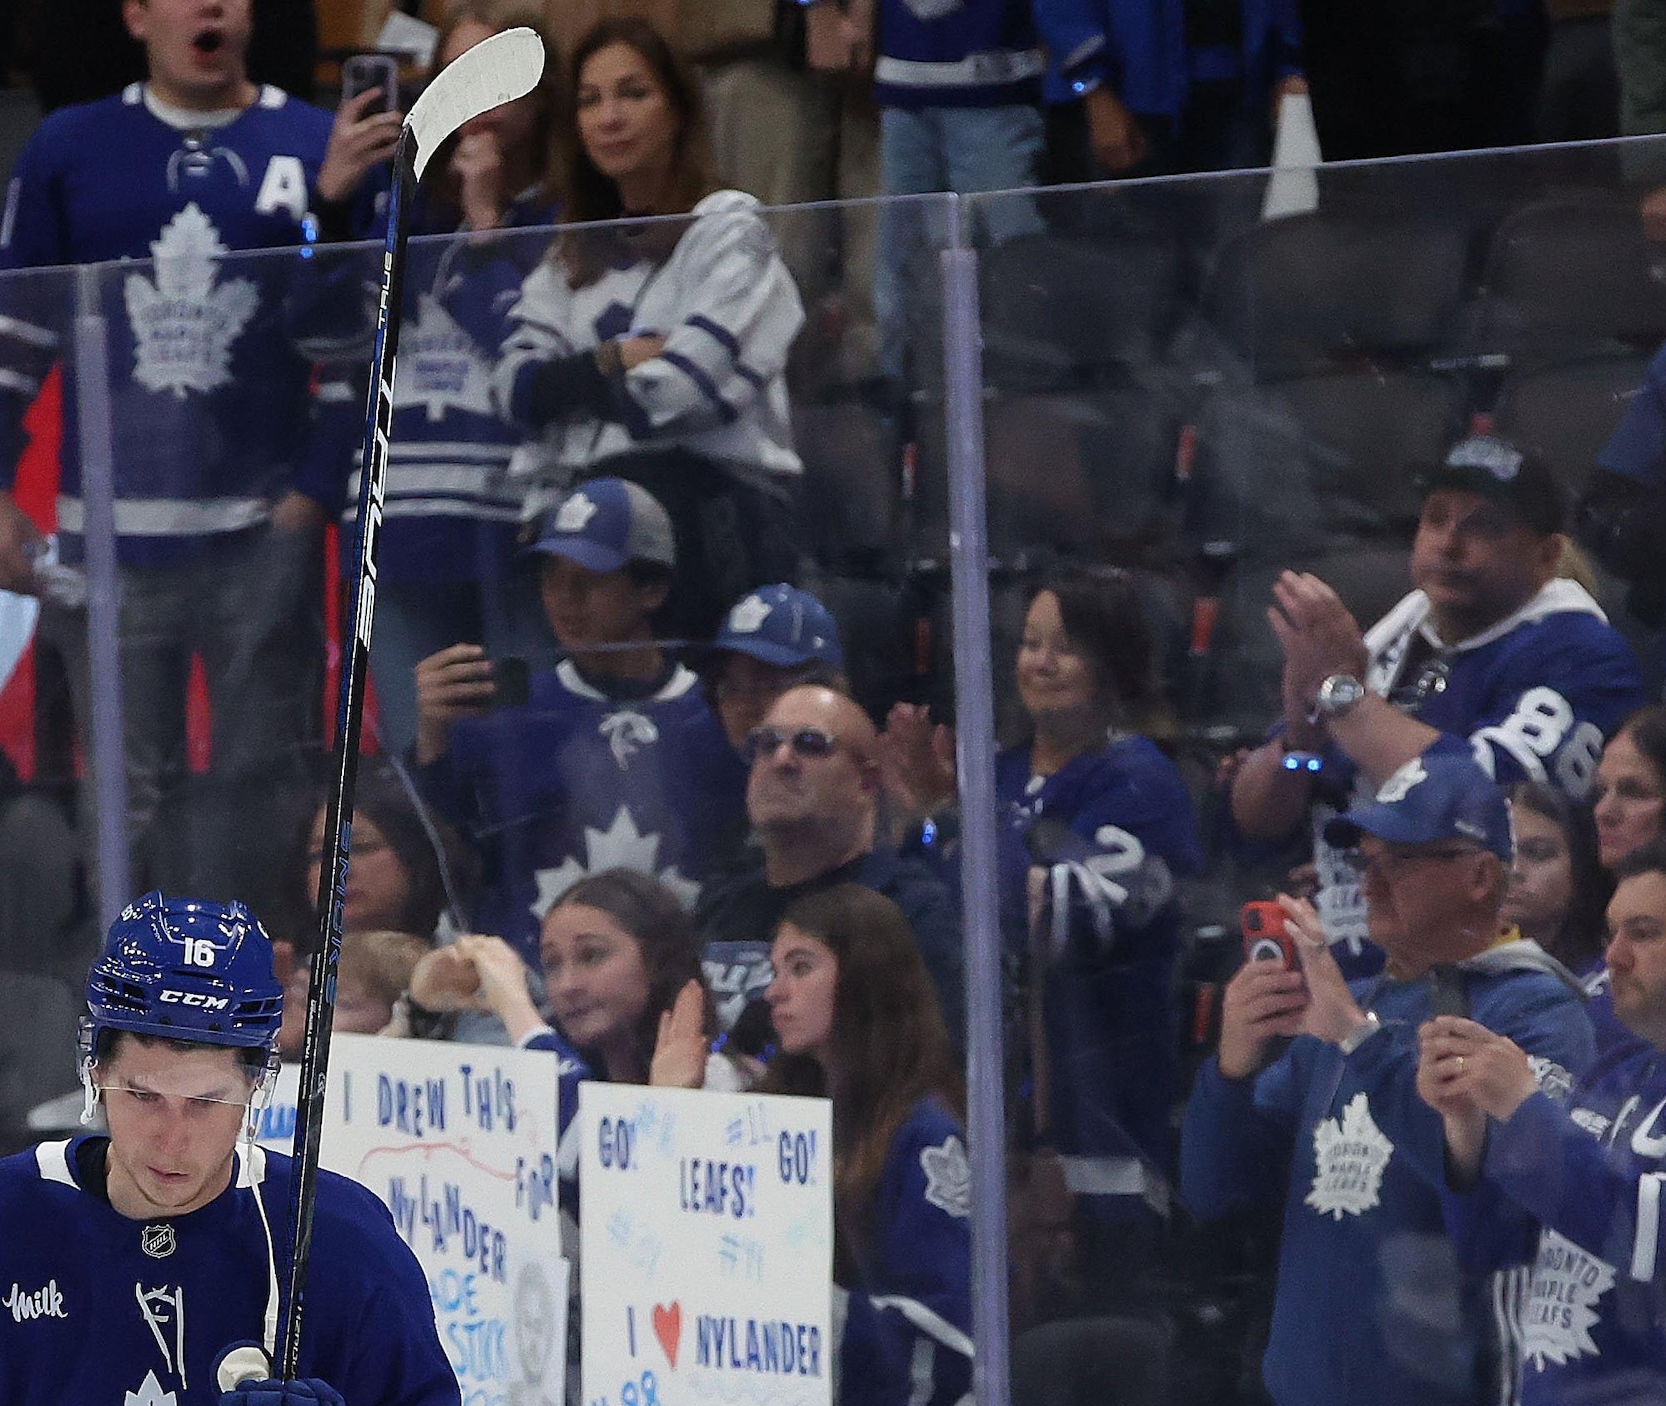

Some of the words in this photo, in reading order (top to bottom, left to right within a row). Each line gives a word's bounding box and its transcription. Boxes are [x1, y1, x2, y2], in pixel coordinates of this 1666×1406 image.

[254, 155, 308, 221] A
[378, 251, 393, 330] TRUE
[184, 937, 215, 968] 16
[159, 989, 229, 1011] CCM
[377, 1073, 446, 1138] DREW
[459, 1064, 517, 1132] THIS
[516, 1153, 554, 1221] FOR
[679, 1156, 756, 1220] LEAFS!
[778, 1128, 817, 1185] GO!
[148, 1232, 170, 1253] NHL
[1, 1279, 68, 1322] Milk
[627, 1304, 637, 1358] I
[695, 1314, 822, 1378] NYLANDER
